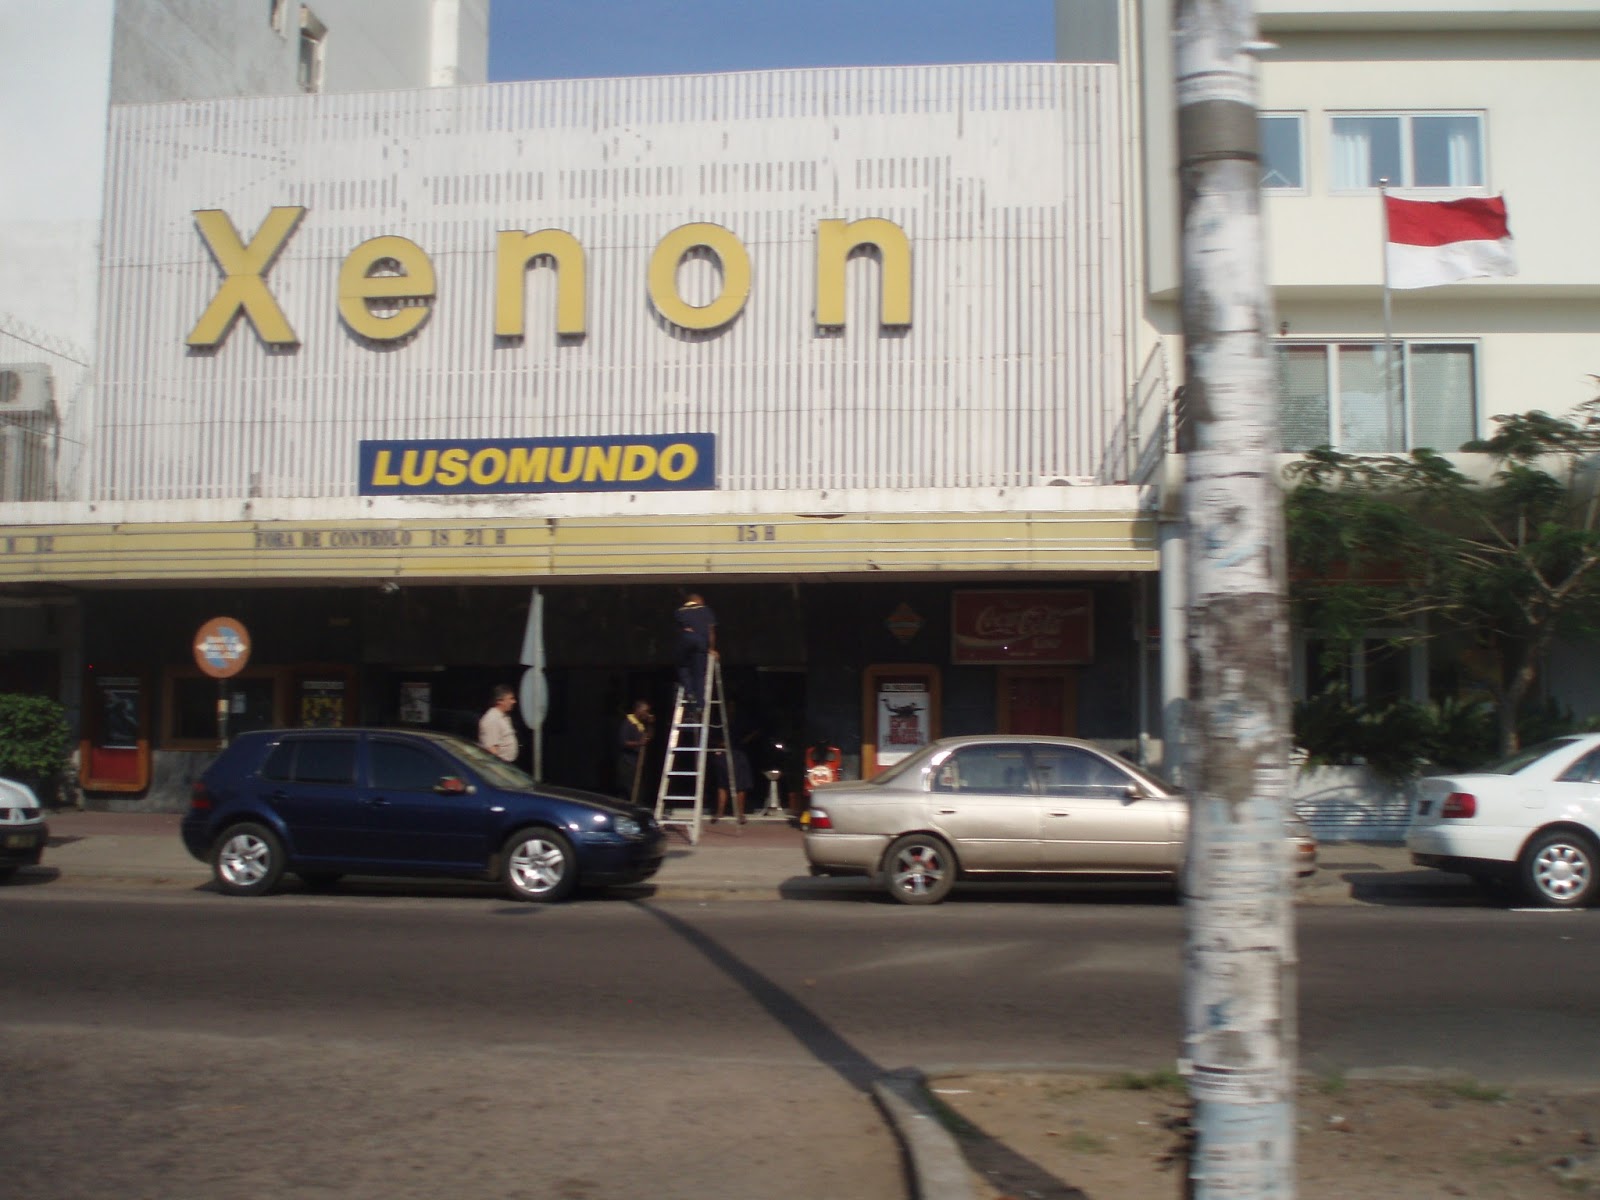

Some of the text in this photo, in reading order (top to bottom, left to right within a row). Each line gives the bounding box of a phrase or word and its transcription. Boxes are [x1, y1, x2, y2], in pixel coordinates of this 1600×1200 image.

[186, 206, 914, 350] Xenon
[371, 442, 698, 487] LUSOMUNDO
[254, 531, 295, 548] FORA
[303, 531, 321, 547] DE
[329, 530, 412, 547] CONTROLO
[464, 529, 483, 546] 21
[737, 525, 758, 542] 15
